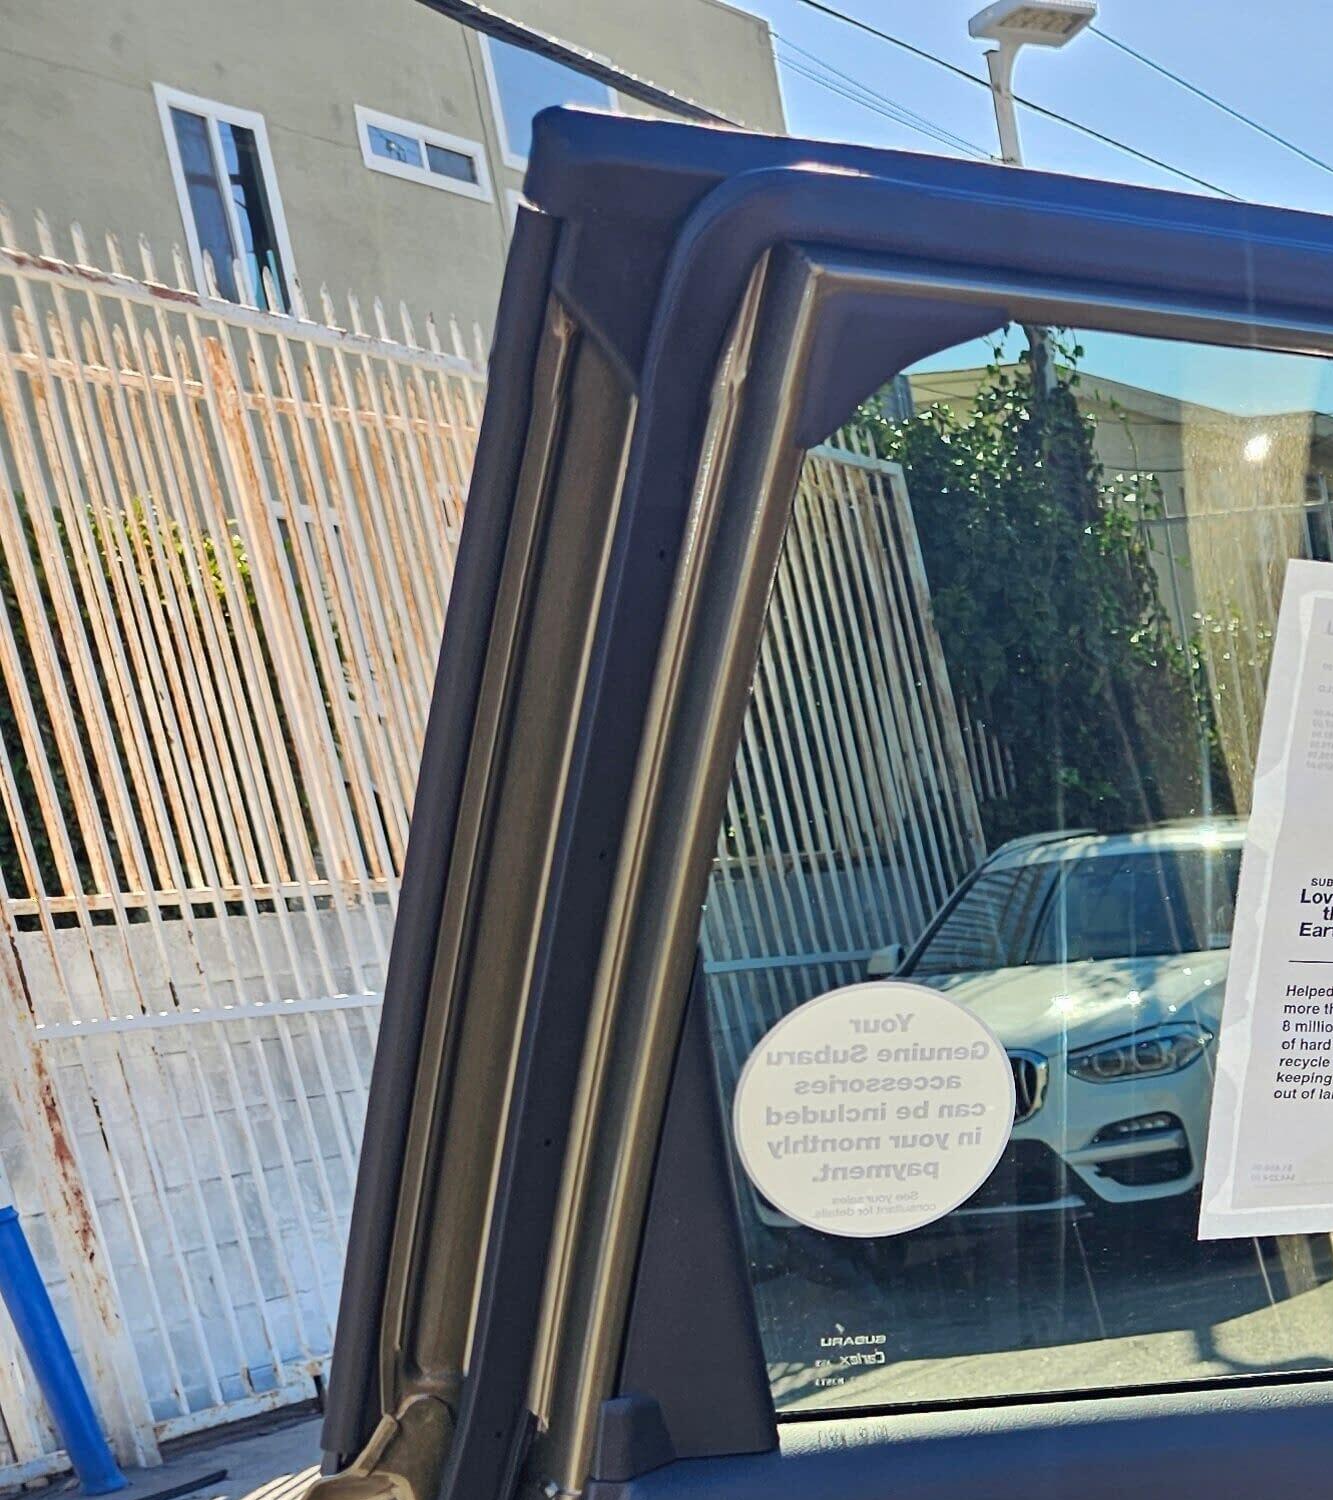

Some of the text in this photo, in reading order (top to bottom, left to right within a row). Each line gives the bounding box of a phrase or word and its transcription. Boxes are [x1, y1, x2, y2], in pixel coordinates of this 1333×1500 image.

[1286, 985, 1333, 998] Helped
[1283, 1004, 1320, 1015] more
[1282, 1020, 1291, 1032] 8
[1281, 1038, 1296, 1050] of
[1300, 1039, 1332, 1050] hard
[1279, 1056, 1330, 1069] recycle
[1276, 1072, 1332, 1085] keeping
[1273, 1089, 1297, 1100] out
[1301, 1088, 1315, 1099] of
